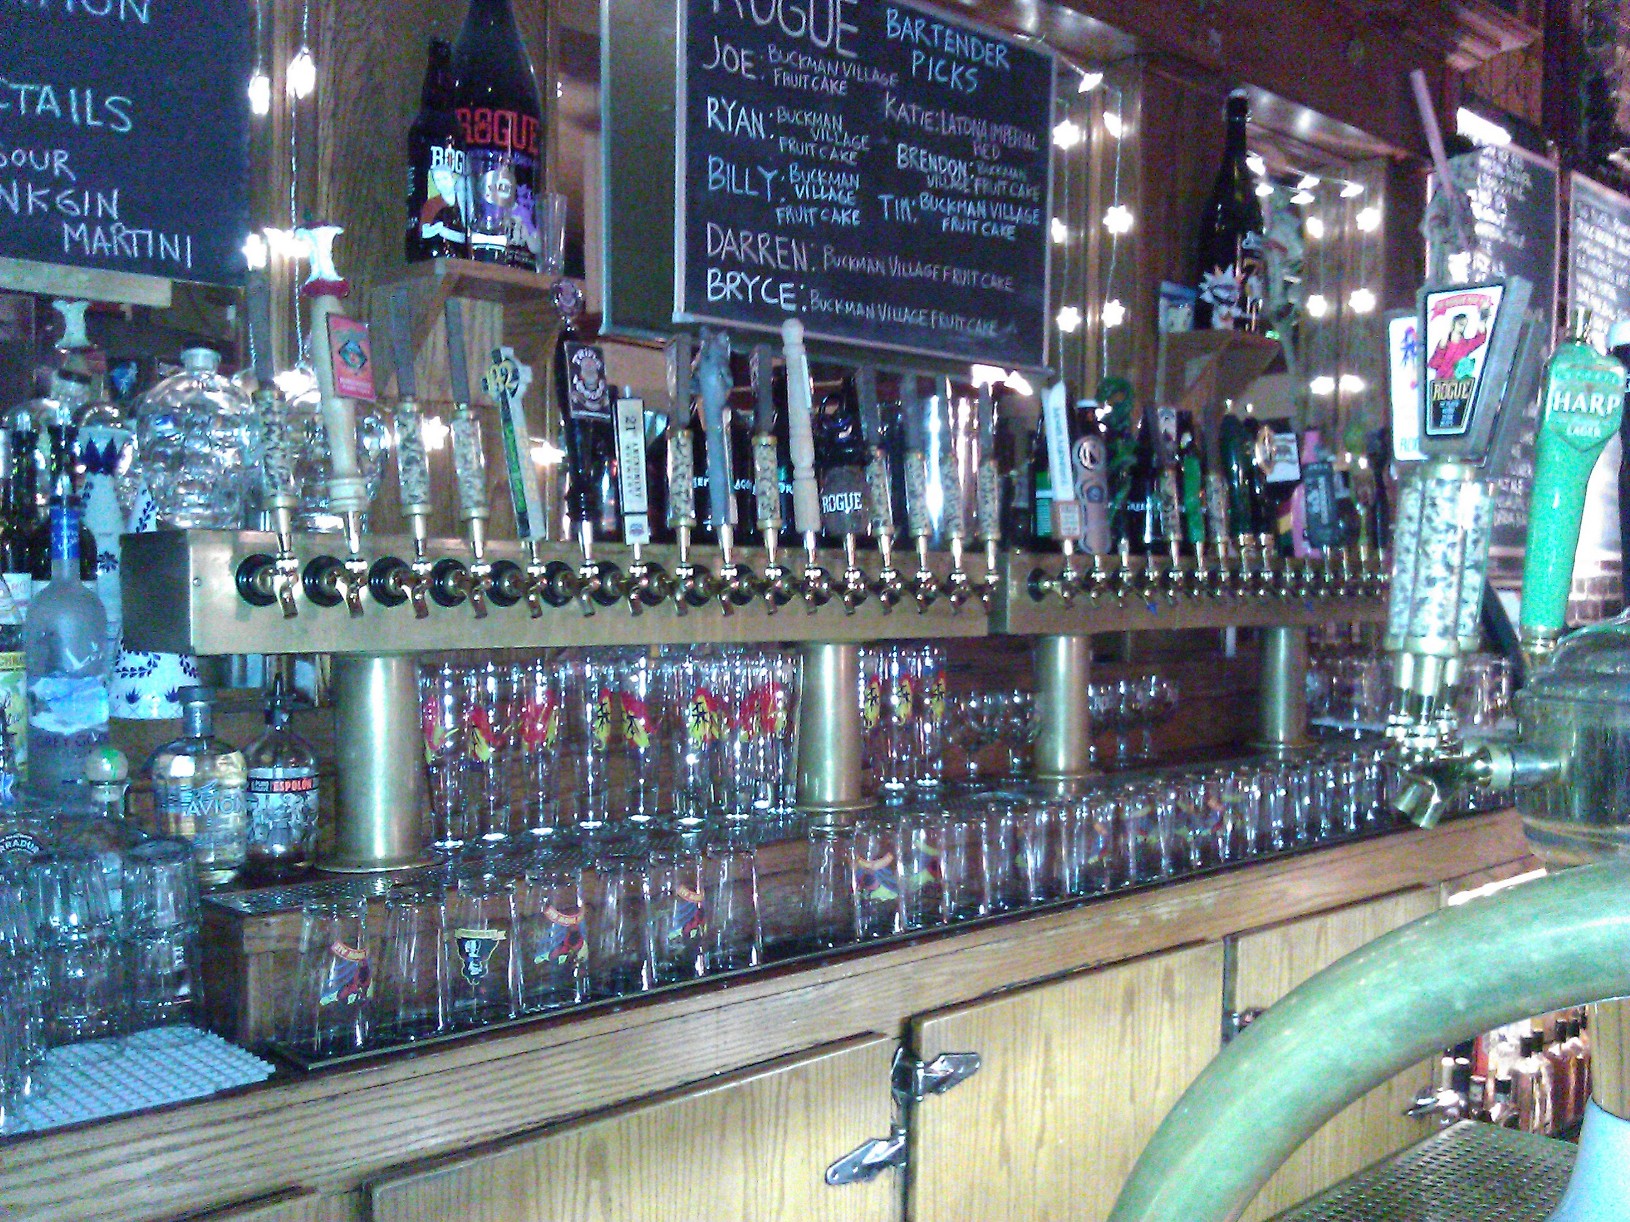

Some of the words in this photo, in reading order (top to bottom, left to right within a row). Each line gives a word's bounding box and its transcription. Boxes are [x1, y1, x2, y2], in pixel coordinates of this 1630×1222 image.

[886, 8, 1011, 72] BARTENDER
[768, 43, 839, 76] BUCKMAN
[842, 61, 900, 88] VILLAGE
[912, 50, 979, 94] PICKS
[0, 82, 132, 133] TAILS
[707, 95, 775, 140] RYAN:
[776, 105, 843, 133] BUCKMAN
[810, 127, 870, 151] VILLAGE
[819, 146, 858, 166] CAKE
[789, 161, 860, 191] BUCKMAN
[56, 187, 118, 220] GIN
[795, 182, 857, 206] VILLAGE
[919, 191, 988, 220] BUCKMAN
[989, 200, 1040, 226] VILLAGE
[820, 206, 862, 228] CAKE
[62, 221, 193, 269] MARTINI
[823, 244, 887, 277] BUCKMAN
[888, 254, 942, 281] VILLAGE
[980, 271, 1016, 293] CAKE
[707, 267, 808, 313] BRYCE:
[810, 288, 876, 321] BUCKMAN
[877, 302, 929, 327] VILLAGE
[1552, 389, 1622, 417] HARP
[822, 491, 863, 514] ROGUE
